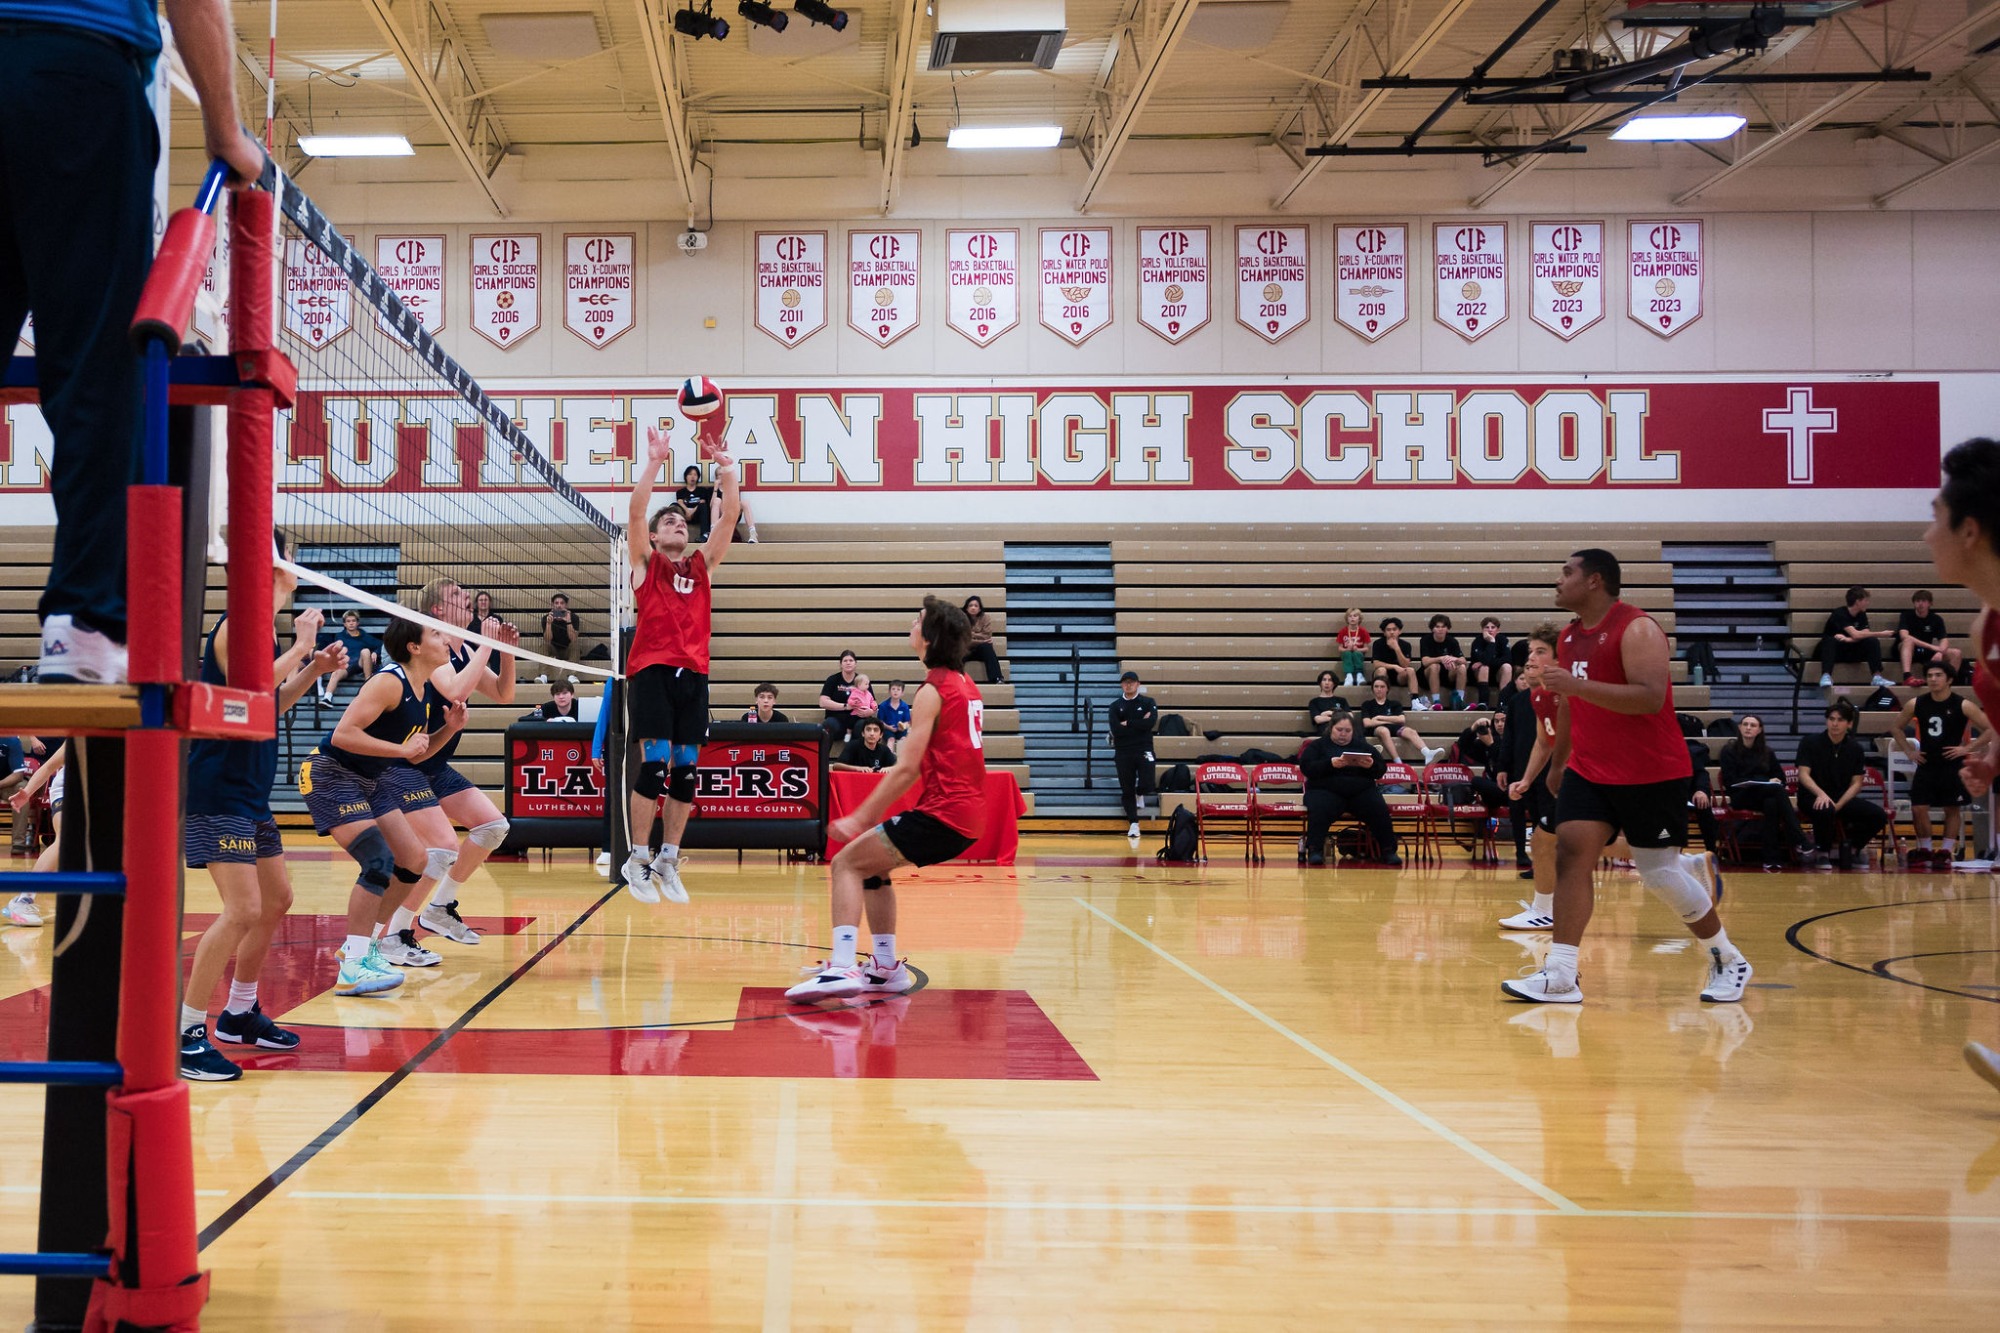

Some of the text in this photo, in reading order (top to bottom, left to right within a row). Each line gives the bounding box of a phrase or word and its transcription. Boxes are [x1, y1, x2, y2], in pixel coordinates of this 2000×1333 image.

[1159, 232, 1189, 256] CIF
[1257, 231, 1287, 254] CIF
[1356, 229, 1387, 253] CIF
[1455, 228, 1486, 252] CIF
[1552, 227, 1582, 251] CIF
[1650, 226, 1681, 250] CIF
[585, 239, 615, 262] CIF
[777, 236, 807, 260] CIF
[870, 236, 900, 259] CIF
[968, 235, 998, 258] CIF
[1060, 233, 1090, 257] CIF
[396, 241, 425, 264] CIF
[491, 240, 520, 263] CIF
[1534, 252, 1600, 263] GIRLS WATER POLO
[1632, 252, 1698, 262] GIRLS BASKETBALL
[1043, 259, 1108, 269] GIRLS WATER POLO
[1141, 258, 1206, 268] GIRLS VOLLEYBALL
[1239, 257, 1305, 267] GIRLS BASKETBALL
[1339, 254, 1403, 265] GIRLS X-COUNTRY
[1438, 254, 1503, 264] GIRLS BASKETBALL
[288, 267, 349, 276] GIRLS X-COUNTR
[380, 266, 440, 276] GIRLS X-COUNTRY
[474, 265, 536, 275] GIRLS SOCCER
[568, 264, 630, 275] GIRLS X-COUNTRY
[760, 263, 823, 273] GIRLS BASKETBALL
[852, 262, 916, 272] GIRLS BASKETBALL
[950, 261, 1014, 271] GIRLS BASKETBALL
[1536, 265, 1599, 278] CHAMPIONS
[1633, 264, 1698, 277] CHAMPIONS
[952, 273, 1013, 285] CHAMPIONS
[1045, 272, 1106, 284] CHAMPIONS
[1143, 270, 1205, 282] CHAMPIONS
[1241, 269, 1304, 282] CHAMPIONS
[1340, 267, 1402, 280] CHAMPIONS
[1440, 267, 1502, 279] CHAMPIONS
[288, 279, 348, 291] CHAMPIONS
[475, 277, 535, 289] CHAMPIONS
[569, 277, 630, 289] CHAMPIONS
[760, 275, 822, 287] CHAMPIONS
[854, 274, 915, 286] CHAMPIONS
[1063, 306, 1089, 318] 2016
[1161, 305, 1187, 317] 2017
[1260, 304, 1287, 316] 2019
[1358, 303, 1386, 316] 2019
[1457, 303, 1487, 316] 2022
[1552, 300, 1582, 312] 2023
[1650, 300, 1681, 312] 2023
[304, 312, 332, 324] 2004
[491, 311, 519, 323] 2006
[585, 310, 614, 322] 2009
[780, 310, 803, 322] 2011
[871, 309, 897, 321] 2015
[969, 308, 996, 320] 2016
[278, 389, 1682, 487] LUTHERAN HIGH SCHOOL
[1928, 716, 1942, 736] 3
[729, 750, 790, 761] THE
